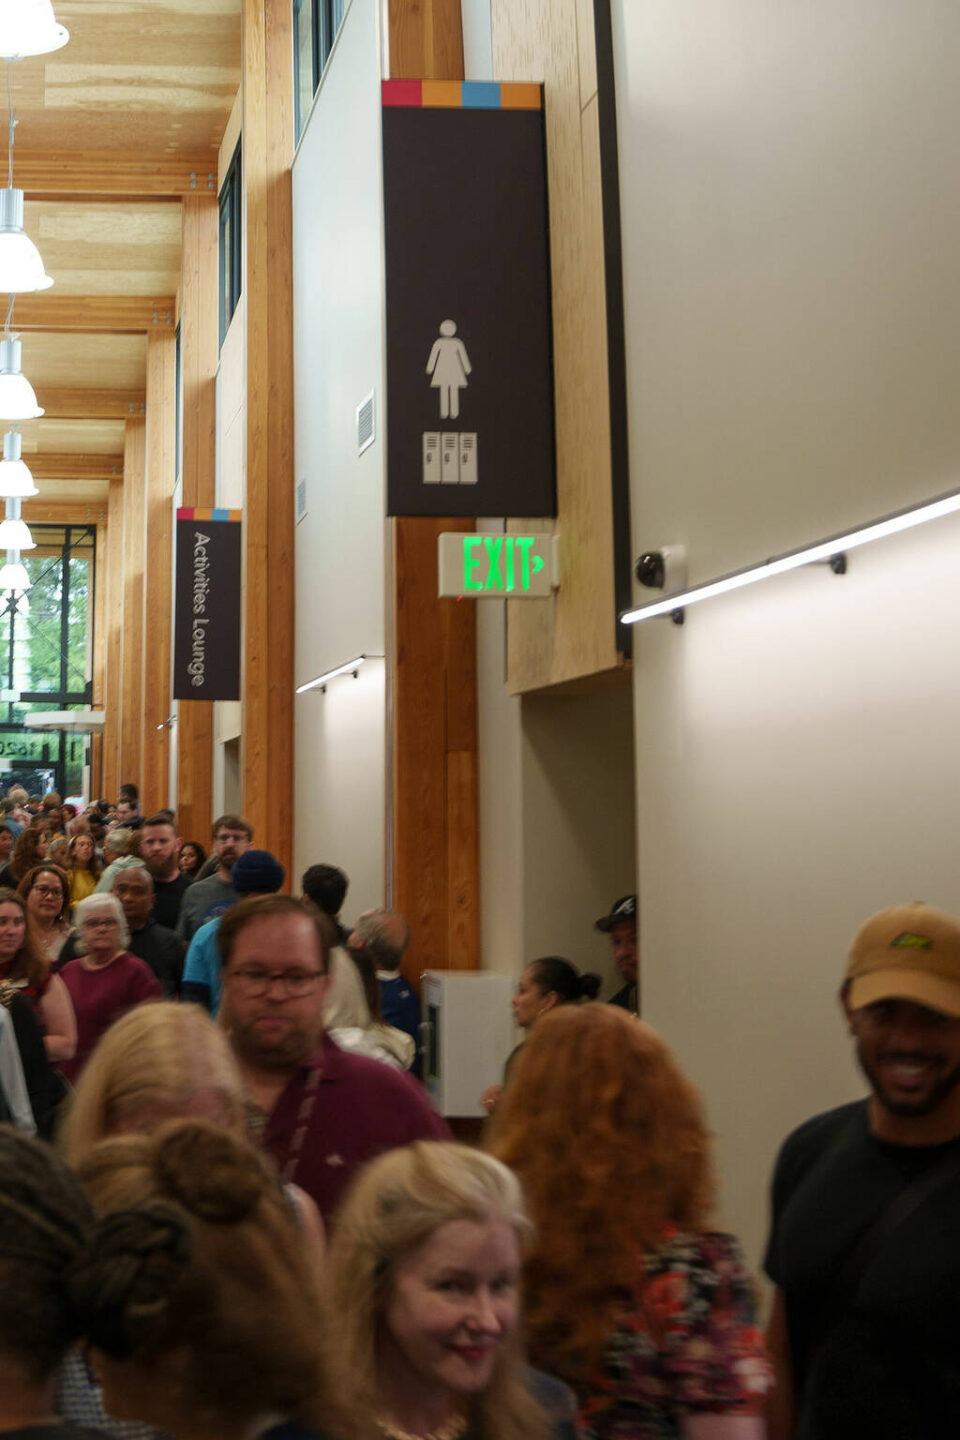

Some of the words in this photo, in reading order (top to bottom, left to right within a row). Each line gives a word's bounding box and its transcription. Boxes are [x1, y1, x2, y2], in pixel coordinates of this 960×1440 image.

[193, 531, 211, 615] Activities
[463, 536, 535, 591] EXIT
[187, 618, 210, 688] Lounge
